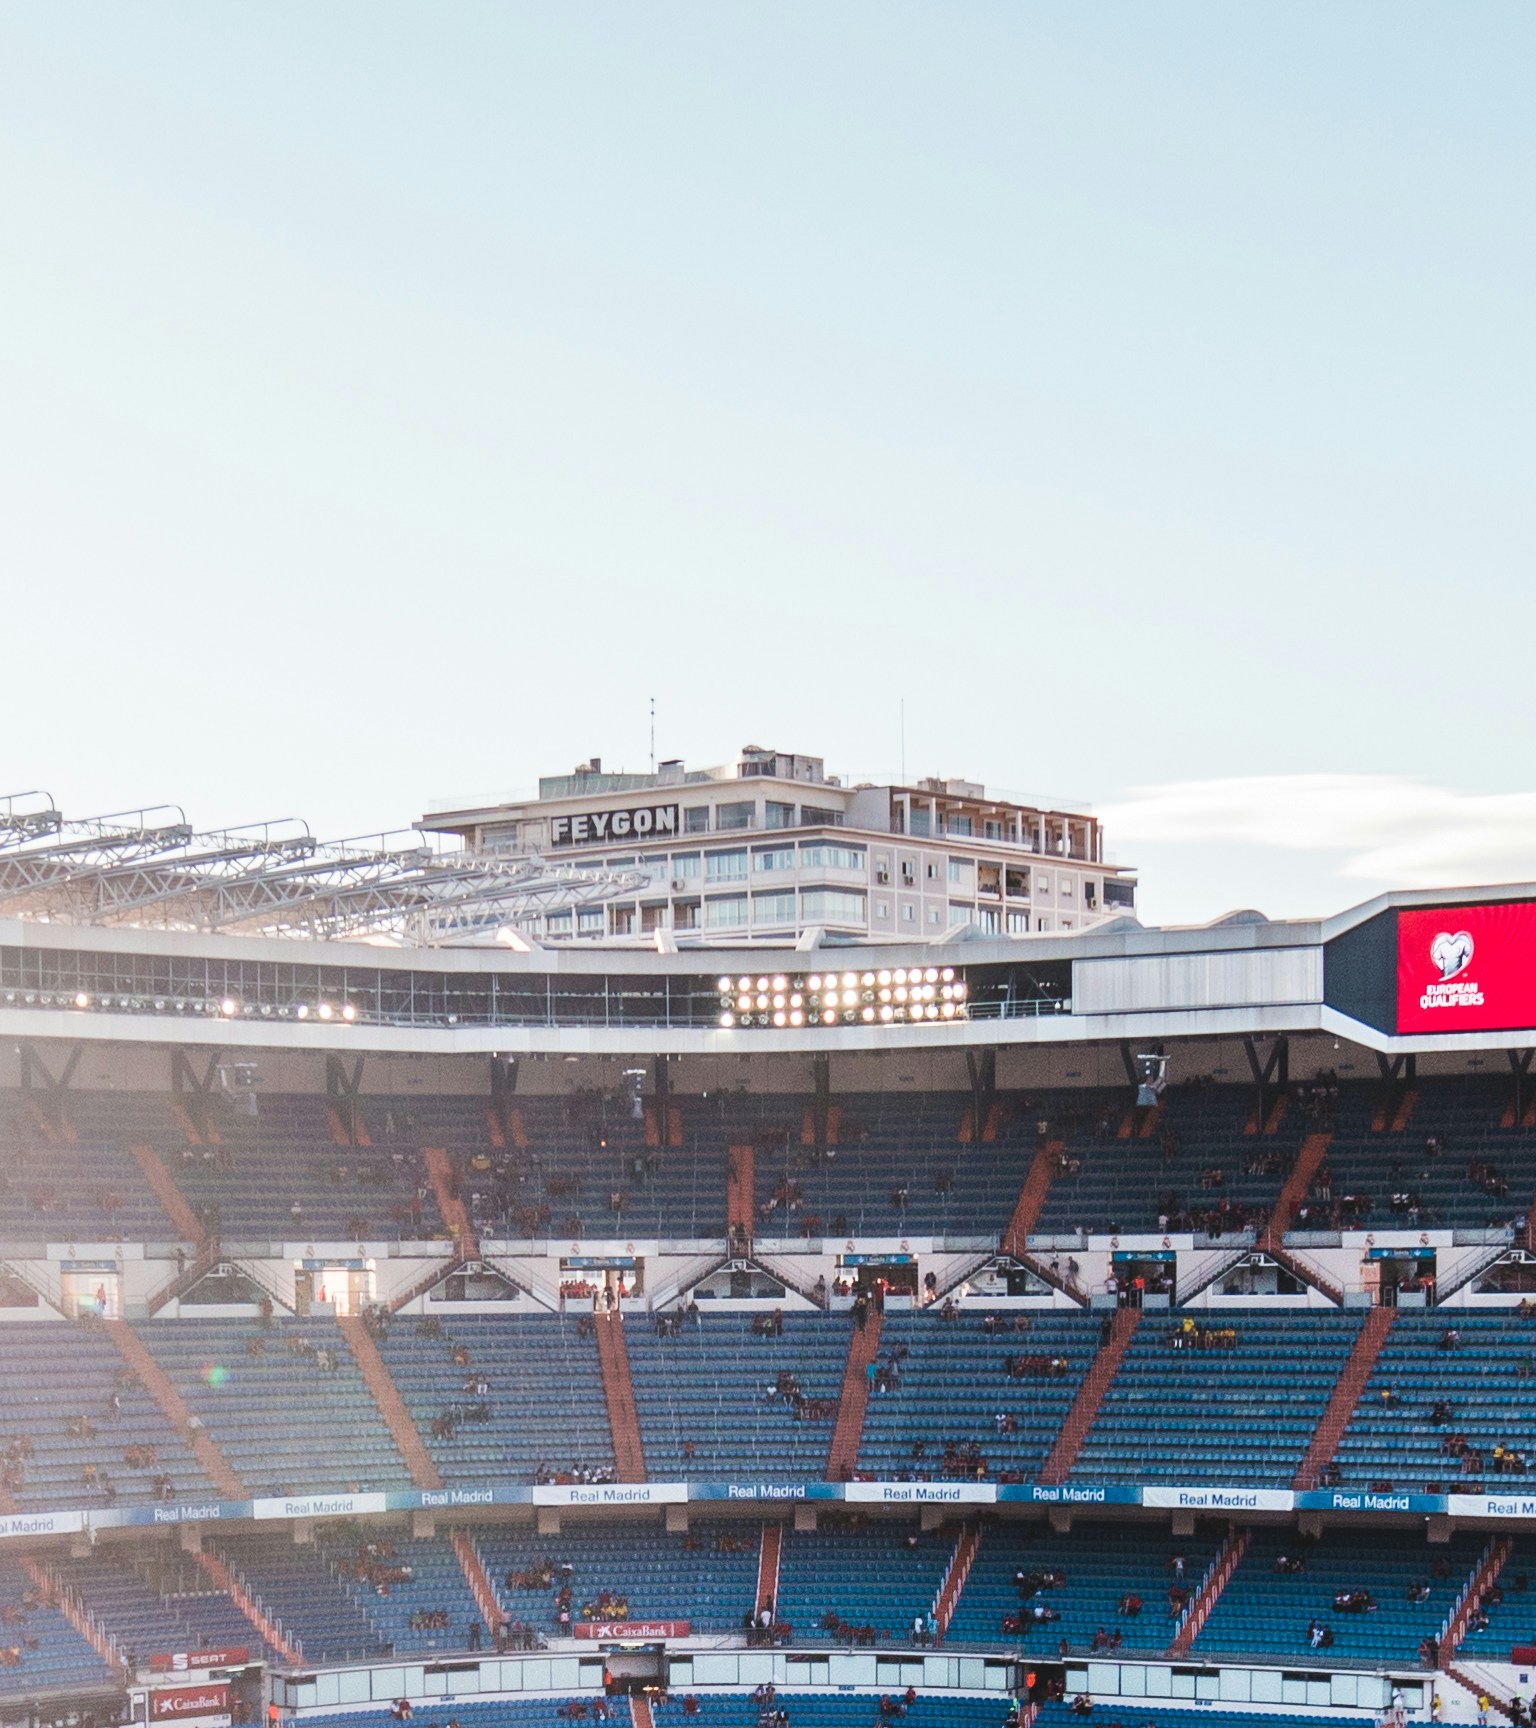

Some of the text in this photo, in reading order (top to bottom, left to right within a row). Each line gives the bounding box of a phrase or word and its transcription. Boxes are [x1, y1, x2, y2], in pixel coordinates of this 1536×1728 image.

[552, 806, 675, 842] FEYGON
[1426, 982, 1478, 995] EUROPEAN
[1419, 992, 1485, 1009] QUALIFIERS
[422, 1490, 493, 1505] Real Madrid
[570, 1489, 650, 1502] Real Madrid
[728, 1485, 805, 1497] Real Madrid
[883, 1488, 960, 1500] Real Madrid
[1033, 1488, 1104, 1501] Real Madrid
[1179, 1494, 1256, 1507] Real Madrid
[1333, 1495, 1409, 1509] Real Madrid
[154, 1506, 219, 1520] Real Madrid
[285, 1500, 353, 1515] Real Madrid
[1487, 1502, 1517, 1514] Real
[11, 1519, 53, 1533] Madrid
[613, 1625, 667, 1637] CaixaBank
[191, 1653, 227, 1665] SEAT
[174, 1695, 220, 1710] CaixaBank
